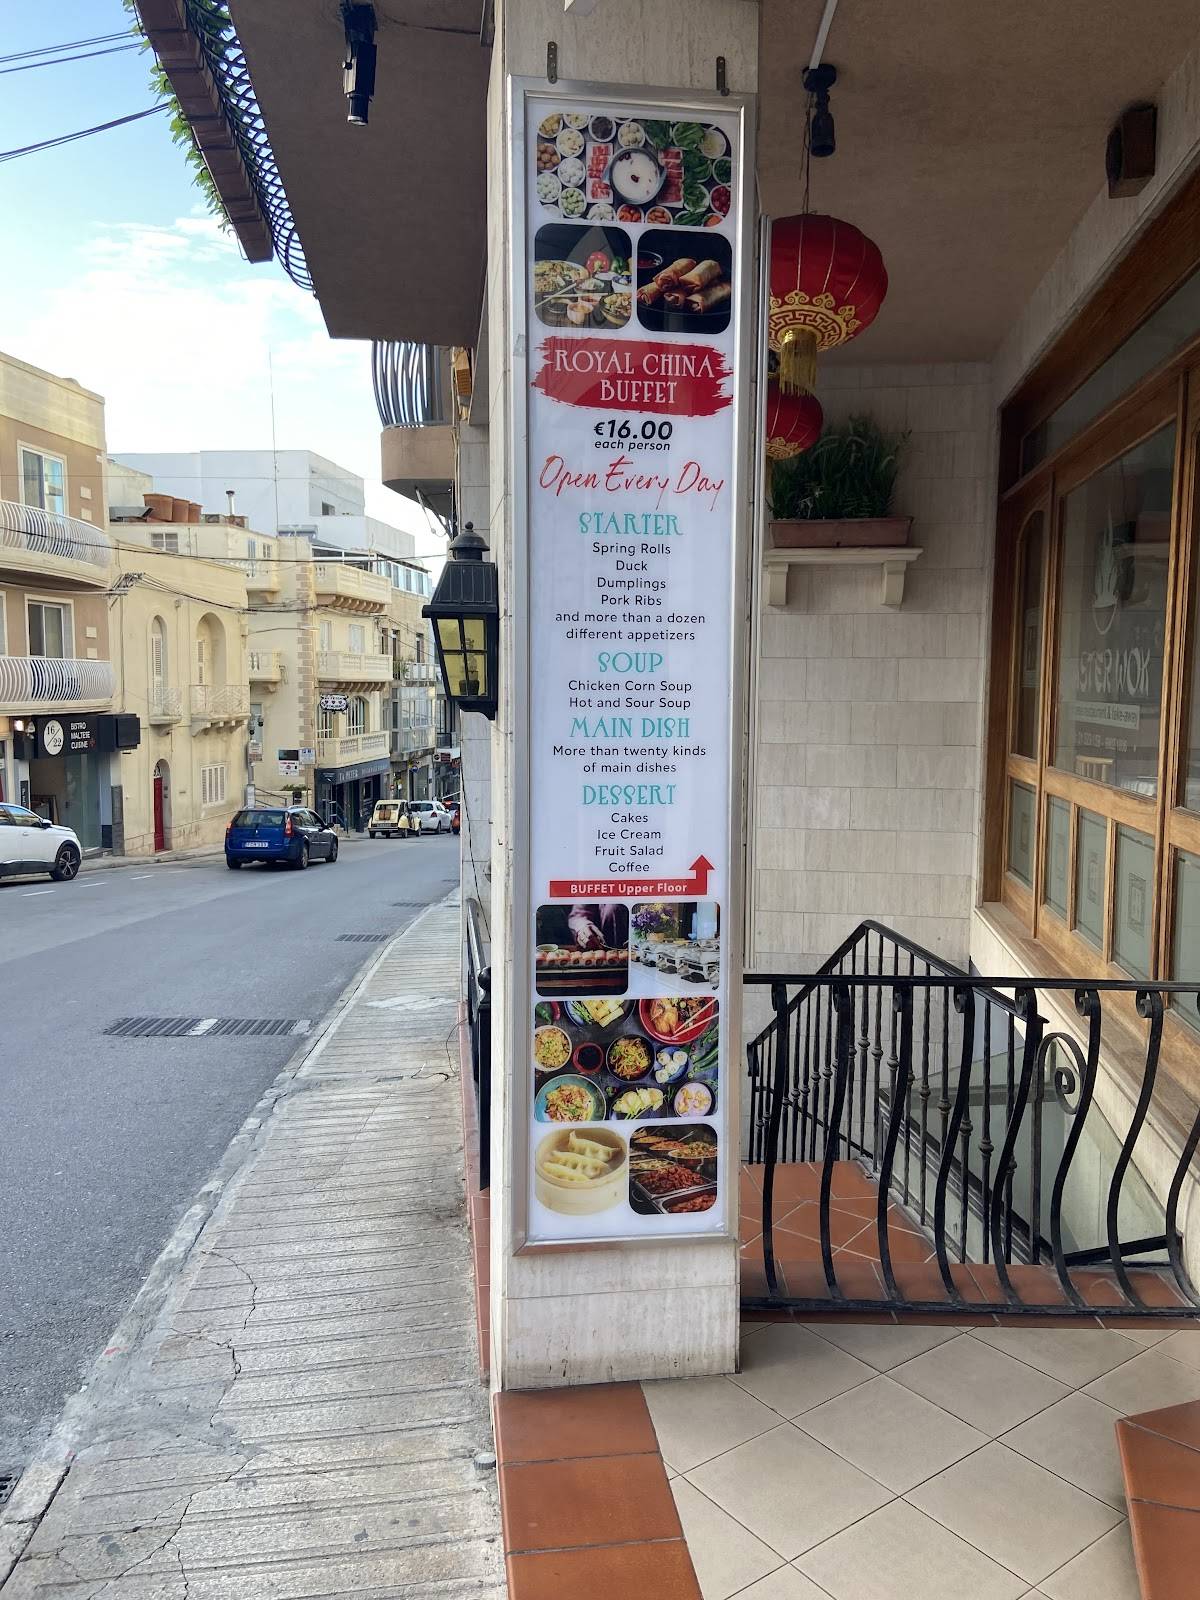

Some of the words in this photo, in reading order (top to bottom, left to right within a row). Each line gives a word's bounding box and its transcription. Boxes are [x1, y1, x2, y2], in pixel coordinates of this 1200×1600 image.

[554, 349, 635, 375] ROYAL
[642, 353, 715, 378] CHINA
[600, 379, 677, 404] BUFFET
[594, 419, 673, 440] €16.00
[594, 439, 624, 450] each
[628, 441, 671, 452] person
[539, 455, 600, 497] Open
[605, 454, 670, 510] Every
[673, 461, 725, 511] Day
[579, 511, 683, 536] STARTER
[592, 541, 636, 556] Spring
[641, 542, 671, 555] Rolls
[616, 560, 648, 571] Duck
[597, 577, 666, 591] Dumplings
[601, 594, 631, 606] Pork
[635, 595, 662, 606] Ribs
[555, 612, 580, 623] and
[585, 614, 617, 624] more
[622, 612, 651, 624] than
[655, 615, 663, 624] a
[667, 612, 706, 625] dozen
[566, 628, 623, 640] different
[627, 629, 695, 642] appetizers
[598, 651, 664, 673] SOUP
[568, 679, 620, 691] Chicken
[625, 680, 656, 691] Corn
[660, 680, 692, 693] Soup
[569, 697, 592, 708] Hot
[597, 697, 621, 708] and
[625, 697, 655, 709] Sour
[659, 697, 691, 711] Soup
[47, 725, 56, 735] 16
[569, 717, 632, 738] MAIN
[641, 717, 690, 738] DISH
[53, 738, 62, 747] 22
[553, 745, 586, 756] More
[590, 745, 619, 756] than
[624, 746, 667, 759] twenty
[672, 745, 706, 757] kinds
[583, 762, 596, 773] of
[601, 762, 632, 773] main
[636, 762, 677, 773] dishes
[582, 784, 677, 805] DESSERT
[611, 812, 649, 823] Cakes
[597, 829, 616, 840] Ice
[620, 829, 662, 840] Cream
[595, 845, 625, 856] Fruit
[630, 845, 664, 856] Salad
[609, 862, 650, 873] Coffee
[570, 884, 615, 894] BUFFET
[618, 883, 654, 896] Upper
[657, 882, 687, 893] Floor
